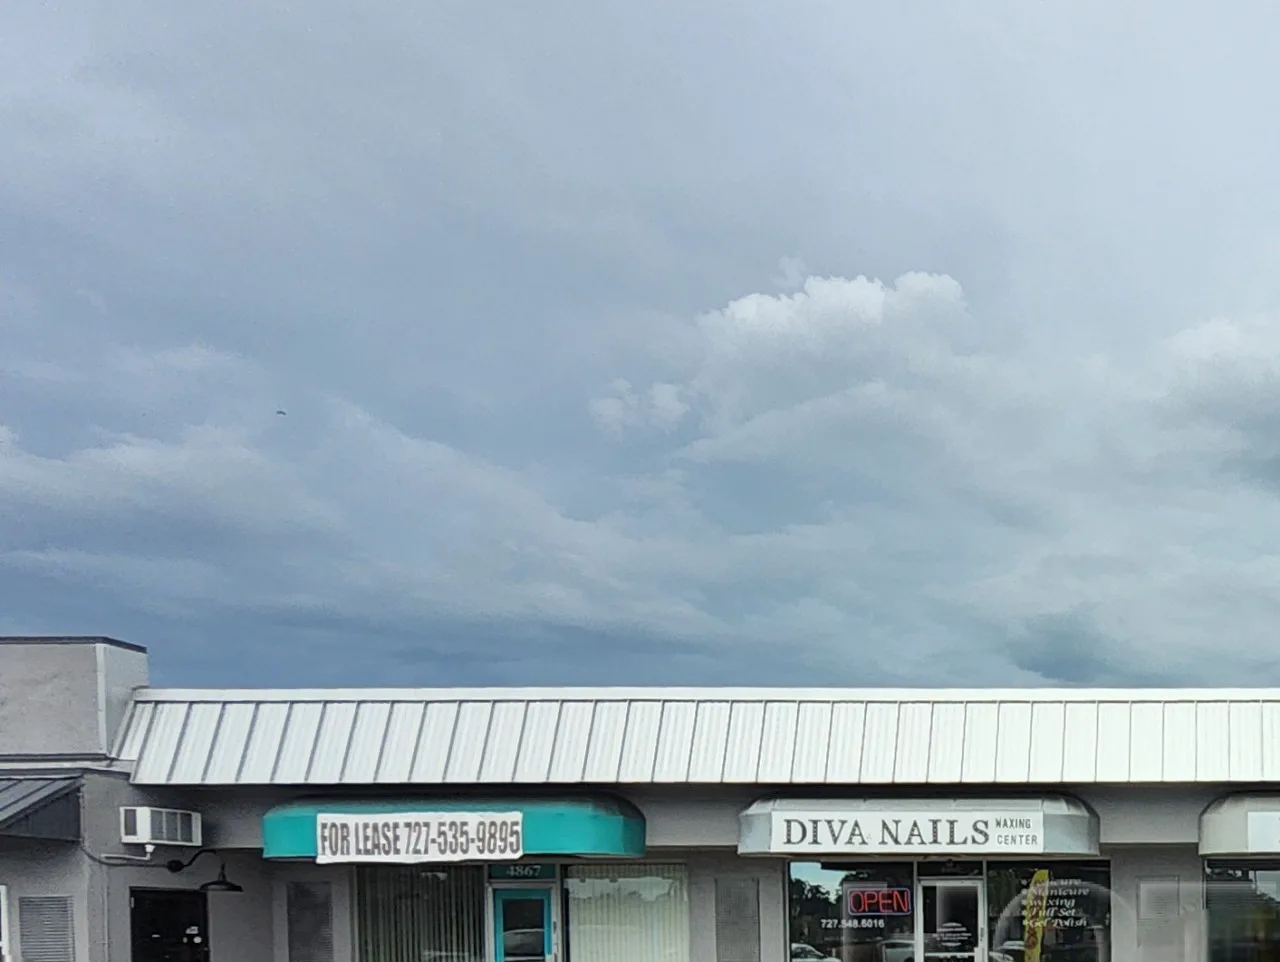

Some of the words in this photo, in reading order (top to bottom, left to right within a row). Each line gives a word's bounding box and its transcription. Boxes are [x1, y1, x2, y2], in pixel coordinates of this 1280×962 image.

[995, 817, 1032, 830] WAXING
[320, 822, 350, 856] FOR
[354, 821, 401, 856] LEASE
[403, 820, 520, 856] 727-535-9895
[783, 818, 868, 846] DIVA
[878, 818, 990, 846] NAILS
[997, 834, 1038, 846] CENTER
[506, 865, 541, 877] 4867
[850, 890, 908, 913] OPEN
[1058, 907, 1076, 917] Set
[1051, 917, 1088, 927] Polish
